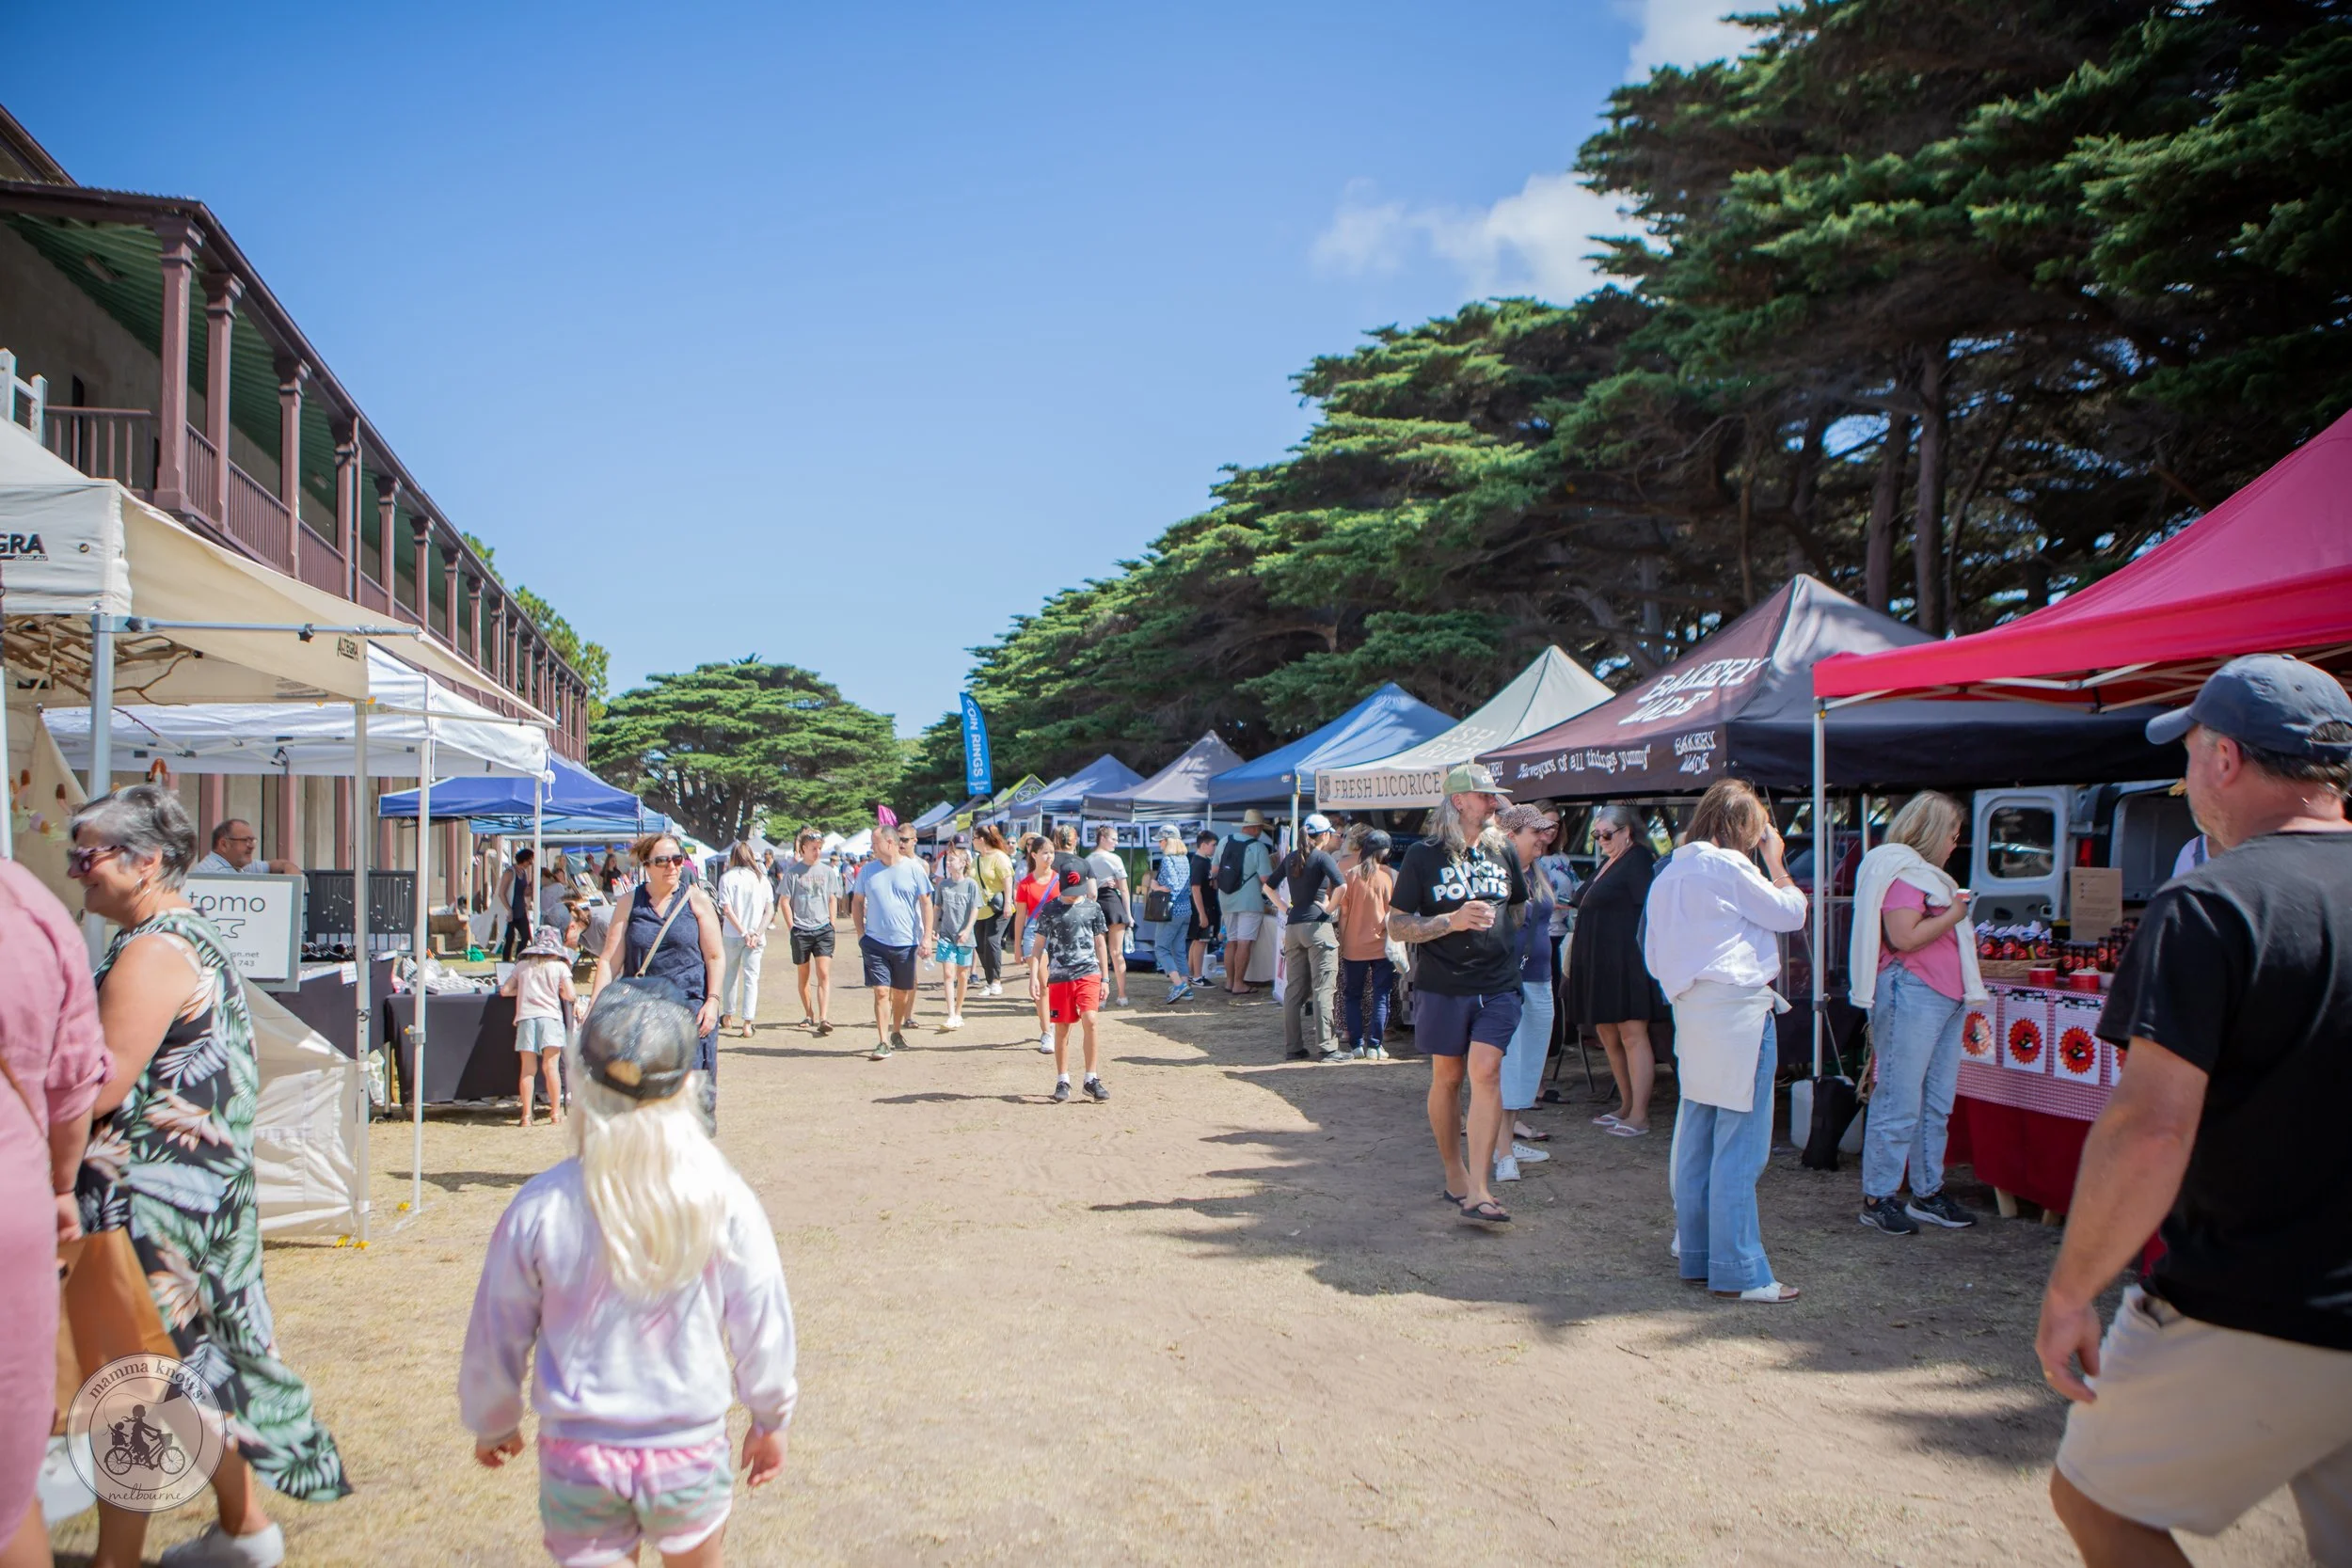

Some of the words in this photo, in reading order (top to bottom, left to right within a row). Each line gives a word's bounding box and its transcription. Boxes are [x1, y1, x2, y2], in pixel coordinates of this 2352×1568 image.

[1637, 657, 1772, 704] BAKERY
[966, 699, 978, 731] COIN
[971, 734, 984, 778] RINGS
[1675, 731, 1716, 755] BAKERY
[1558, 753, 1568, 772] of
[1570, 753, 1584, 771] all
[1586, 749, 1617, 774] things
[1334, 778, 1373, 799] FRESH
[1376, 771, 1441, 798] LICORICE
[1440, 860, 1507, 884] PINCH
[1433, 877, 1509, 901] POINTS
